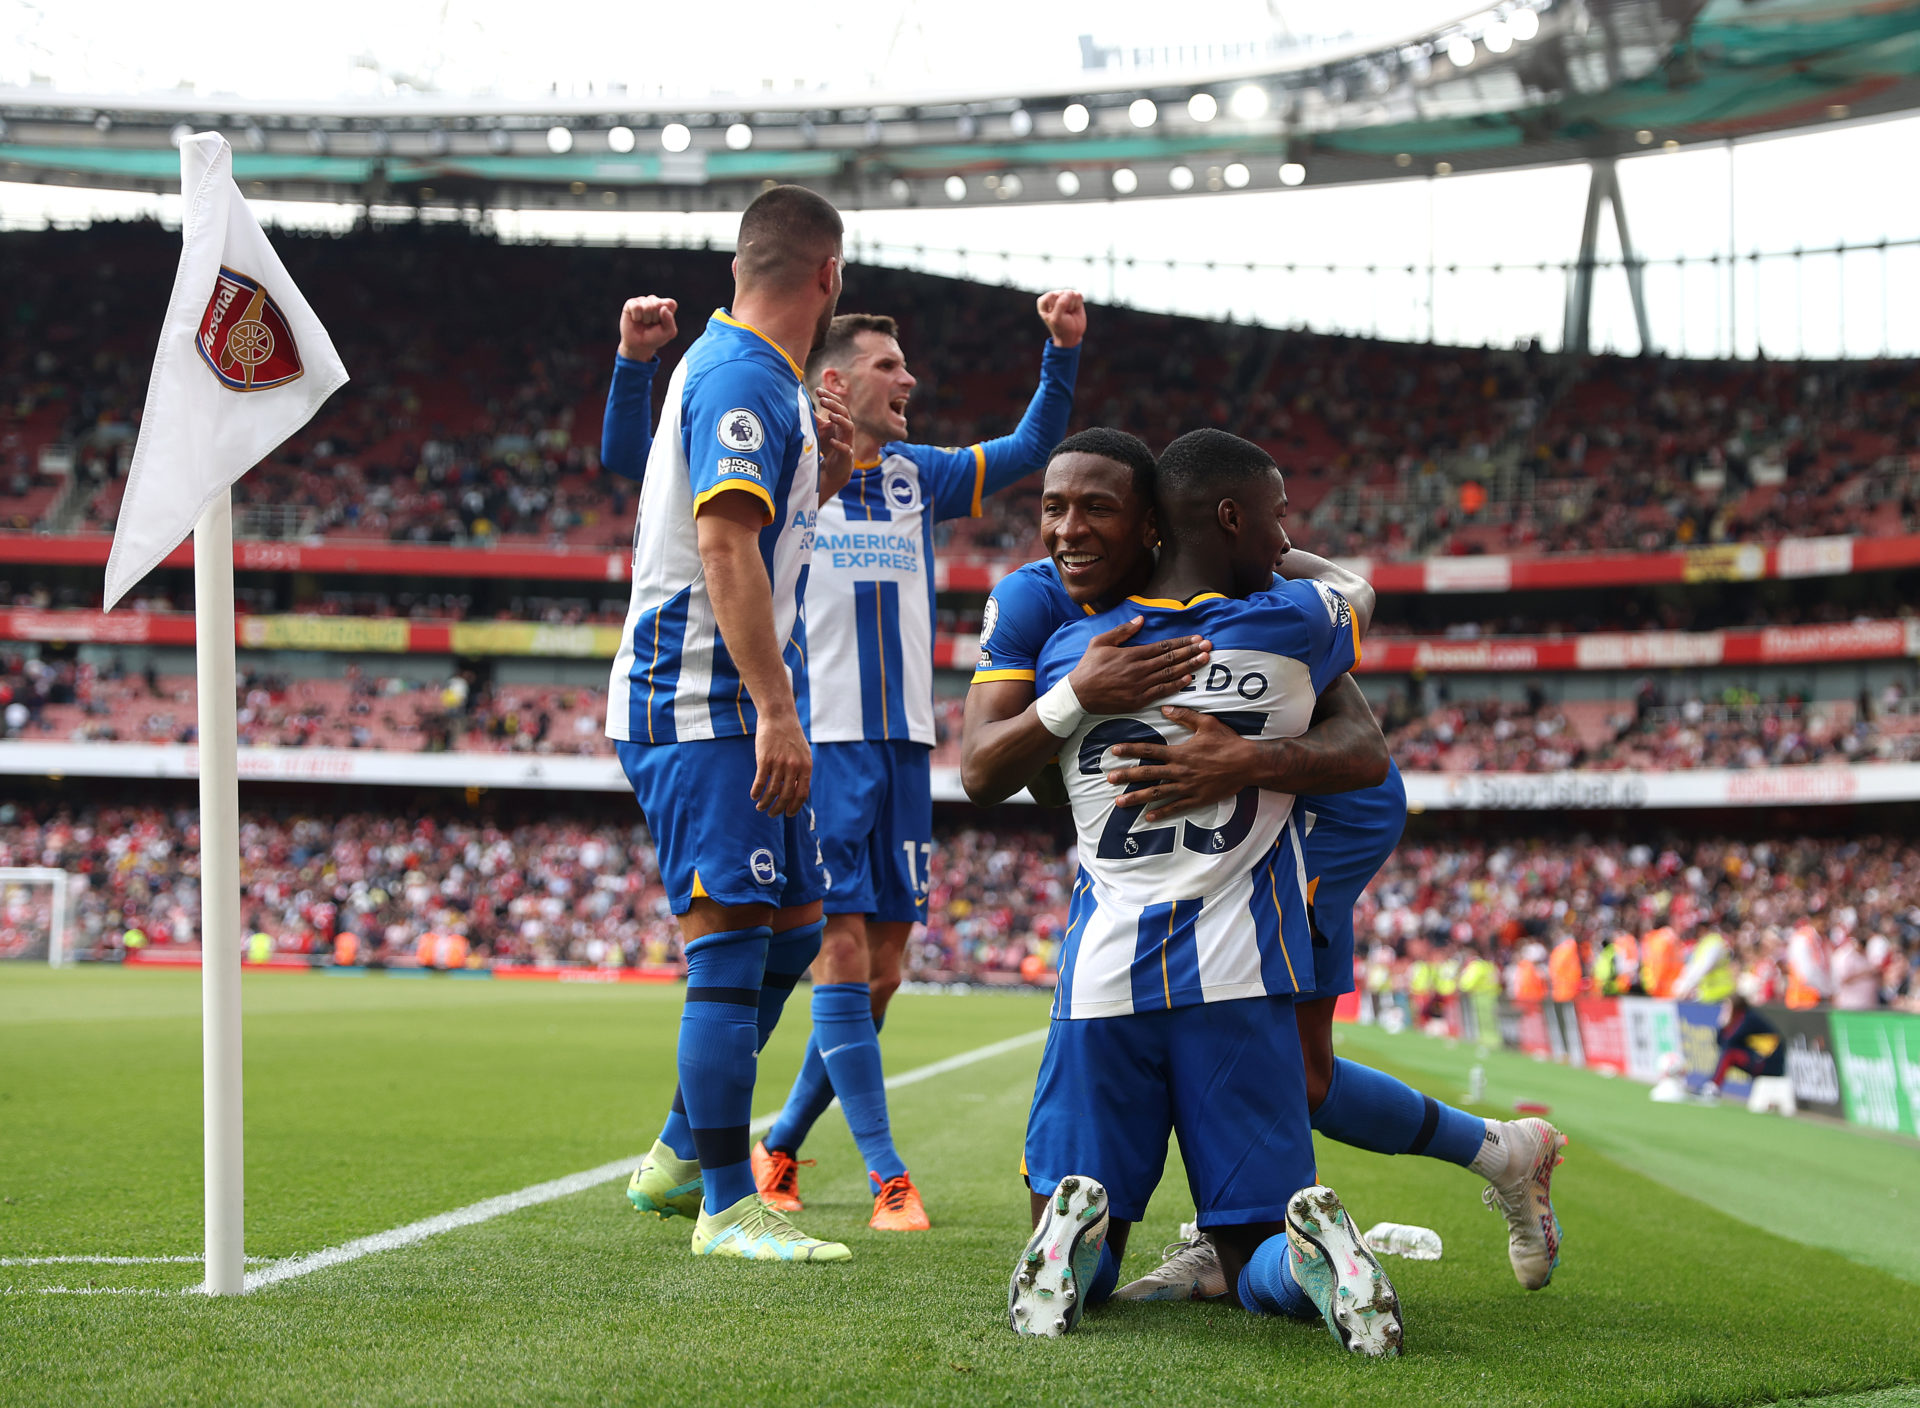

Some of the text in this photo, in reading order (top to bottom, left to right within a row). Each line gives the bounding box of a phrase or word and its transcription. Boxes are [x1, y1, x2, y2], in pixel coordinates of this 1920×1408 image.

[203, 281, 240, 354] Arsenal
[813, 534, 916, 554] AMERICAN
[832, 552, 918, 573] EXPRESS
